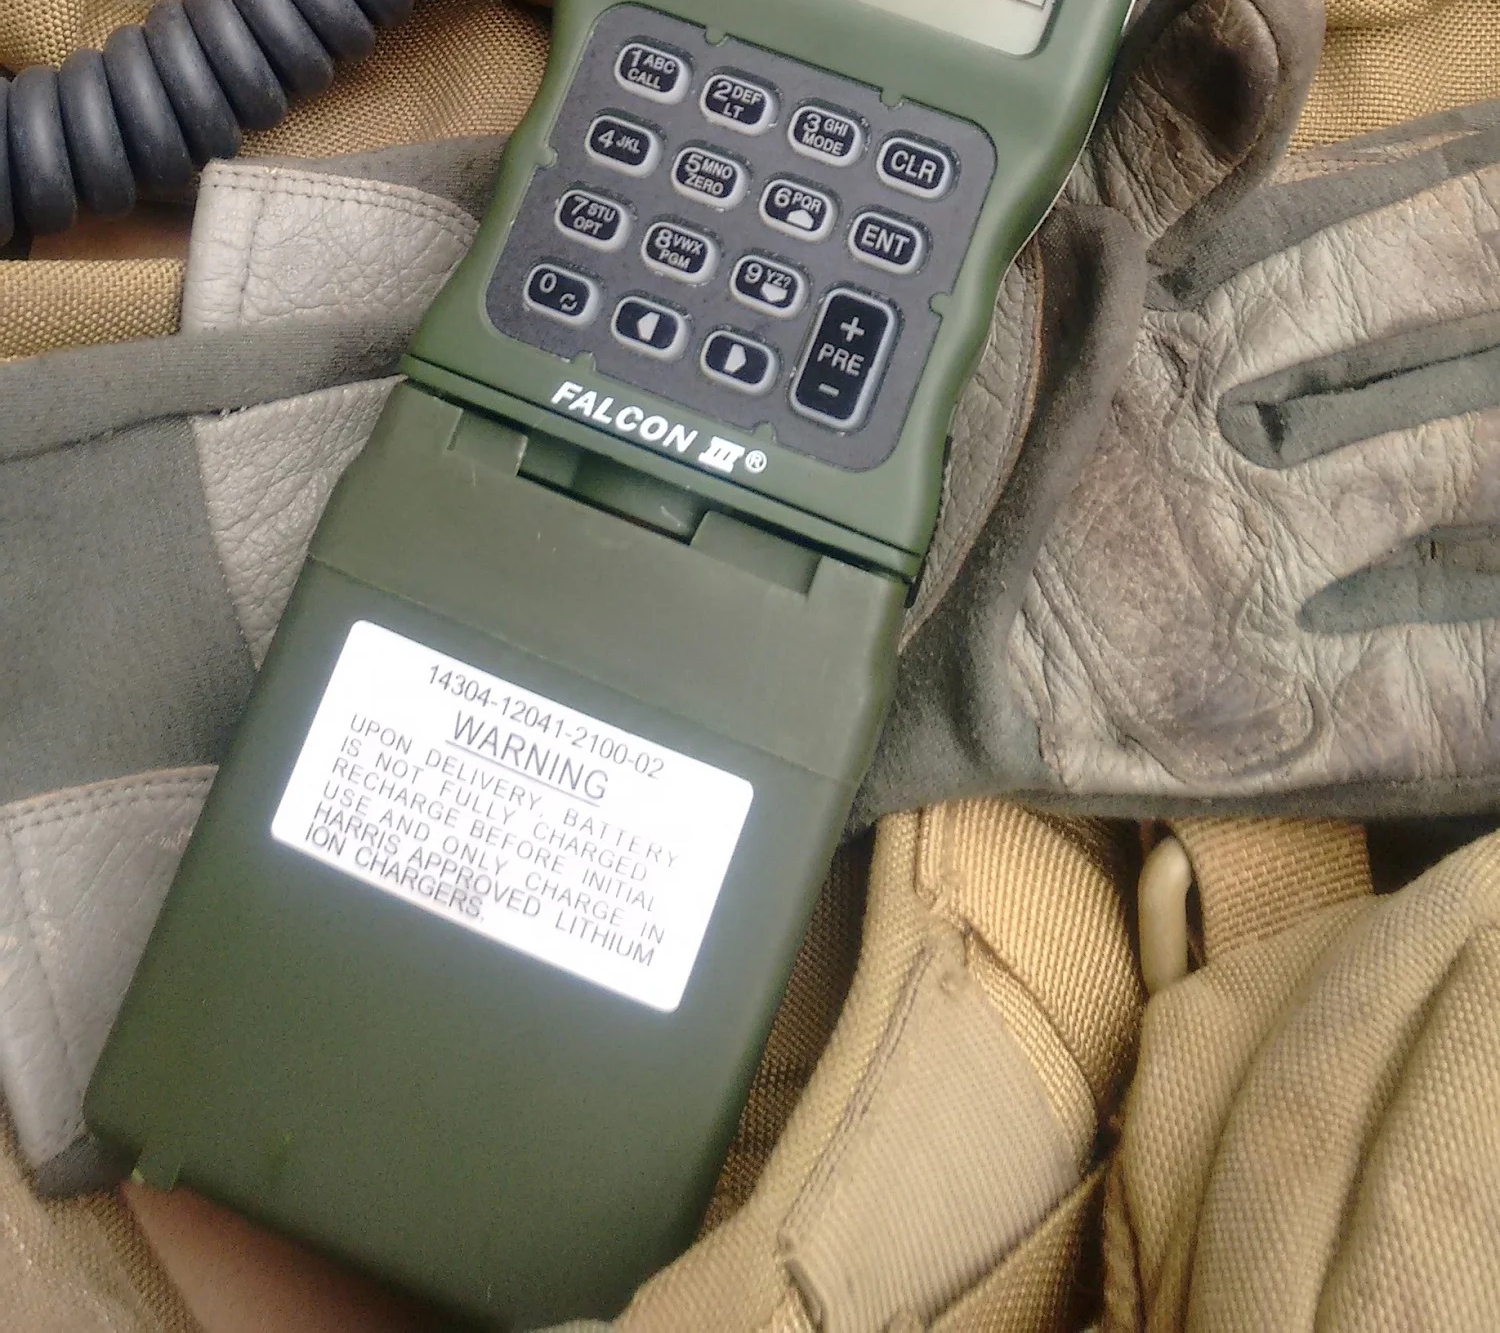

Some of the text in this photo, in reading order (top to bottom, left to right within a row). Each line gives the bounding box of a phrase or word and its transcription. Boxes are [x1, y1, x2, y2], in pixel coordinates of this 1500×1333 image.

[627, 68, 661, 89] CALL
[722, 103, 745, 119] LT
[802, 132, 845, 156] MODE
[890, 150, 937, 183] CLR
[684, 173, 724, 196] ZERO
[573, 216, 603, 235] OPT
[860, 223, 910, 257] ENT
[658, 249, 691, 269] PGM
[539, 272, 557, 294] 0
[817, 343, 865, 376] PRE
[552, 381, 698, 452] FALCON
[430, 665, 665, 779] 14304-12041-2100-02
[454, 710, 608, 799] WARNING
[350, 713, 412, 755] UPON
[563, 808, 678, 867] BATTERY
[340, 736, 647, 882] IS NOT FULLY CHARGED
[305, 822, 347, 856] ION
[332, 757, 655, 912] RECHARGE BEFORE INITIAL
[323, 780, 664, 944] USE AND ONLY CHARGE IN
[314, 800, 655, 966] HARRIS APPROVED LITHIUM
